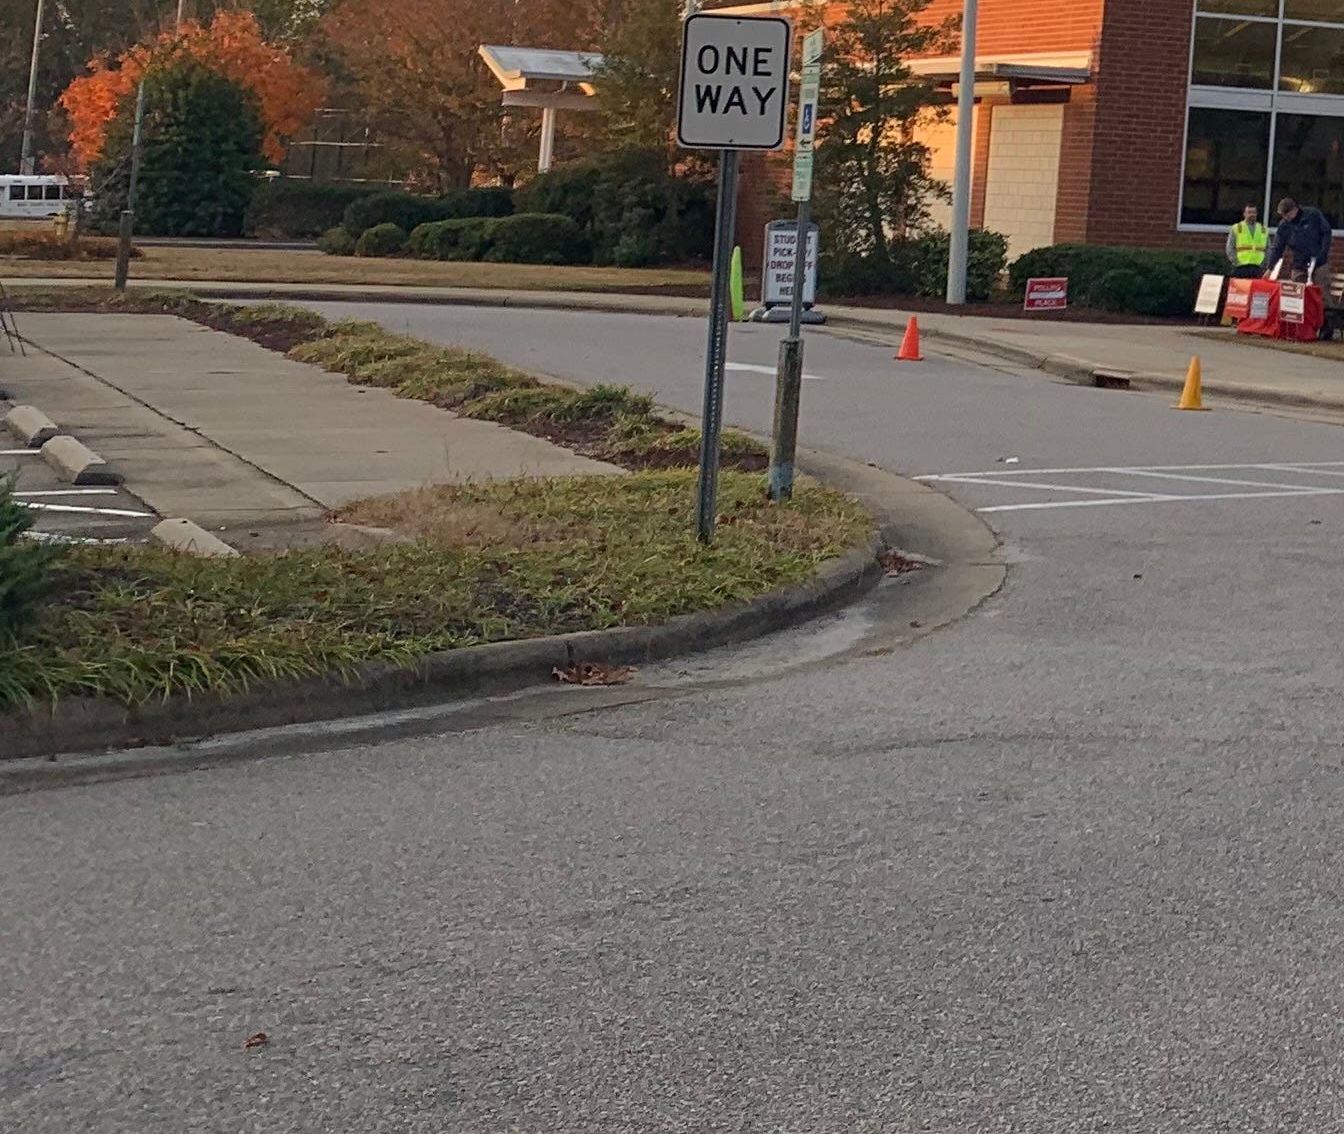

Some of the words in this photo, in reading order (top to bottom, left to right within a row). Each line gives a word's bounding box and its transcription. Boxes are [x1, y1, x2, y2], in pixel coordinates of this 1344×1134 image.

[697, 44, 773, 77] ONE
[695, 84, 777, 116] WAY
[774, 235, 812, 244] STUDT
